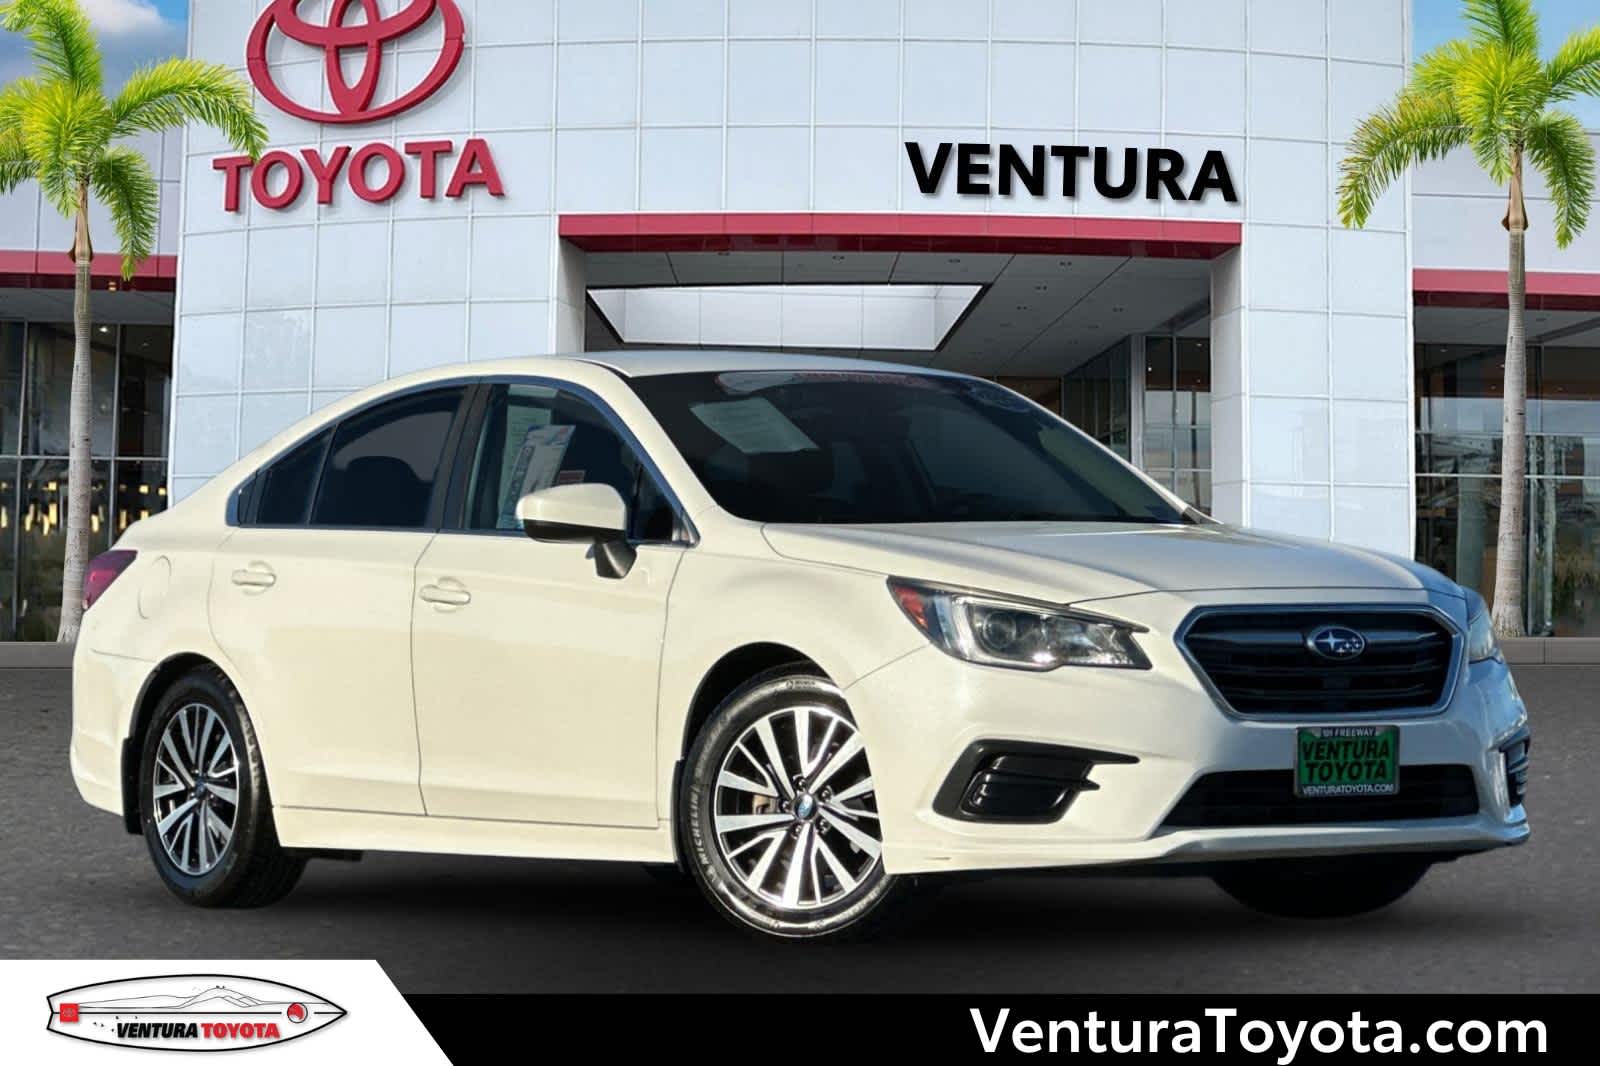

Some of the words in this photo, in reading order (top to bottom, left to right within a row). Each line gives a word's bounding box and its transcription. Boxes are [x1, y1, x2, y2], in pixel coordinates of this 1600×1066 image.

[213, 139, 504, 212] TOYOTA
[904, 141, 1238, 203] VENTURA
[1334, 727, 1374, 737] FREEWAY
[1303, 740, 1389, 760] VENTURA
[1306, 760, 1386, 781] TOYOTA
[1302, 783, 1394, 795] VENTURATOYOTA.COM
